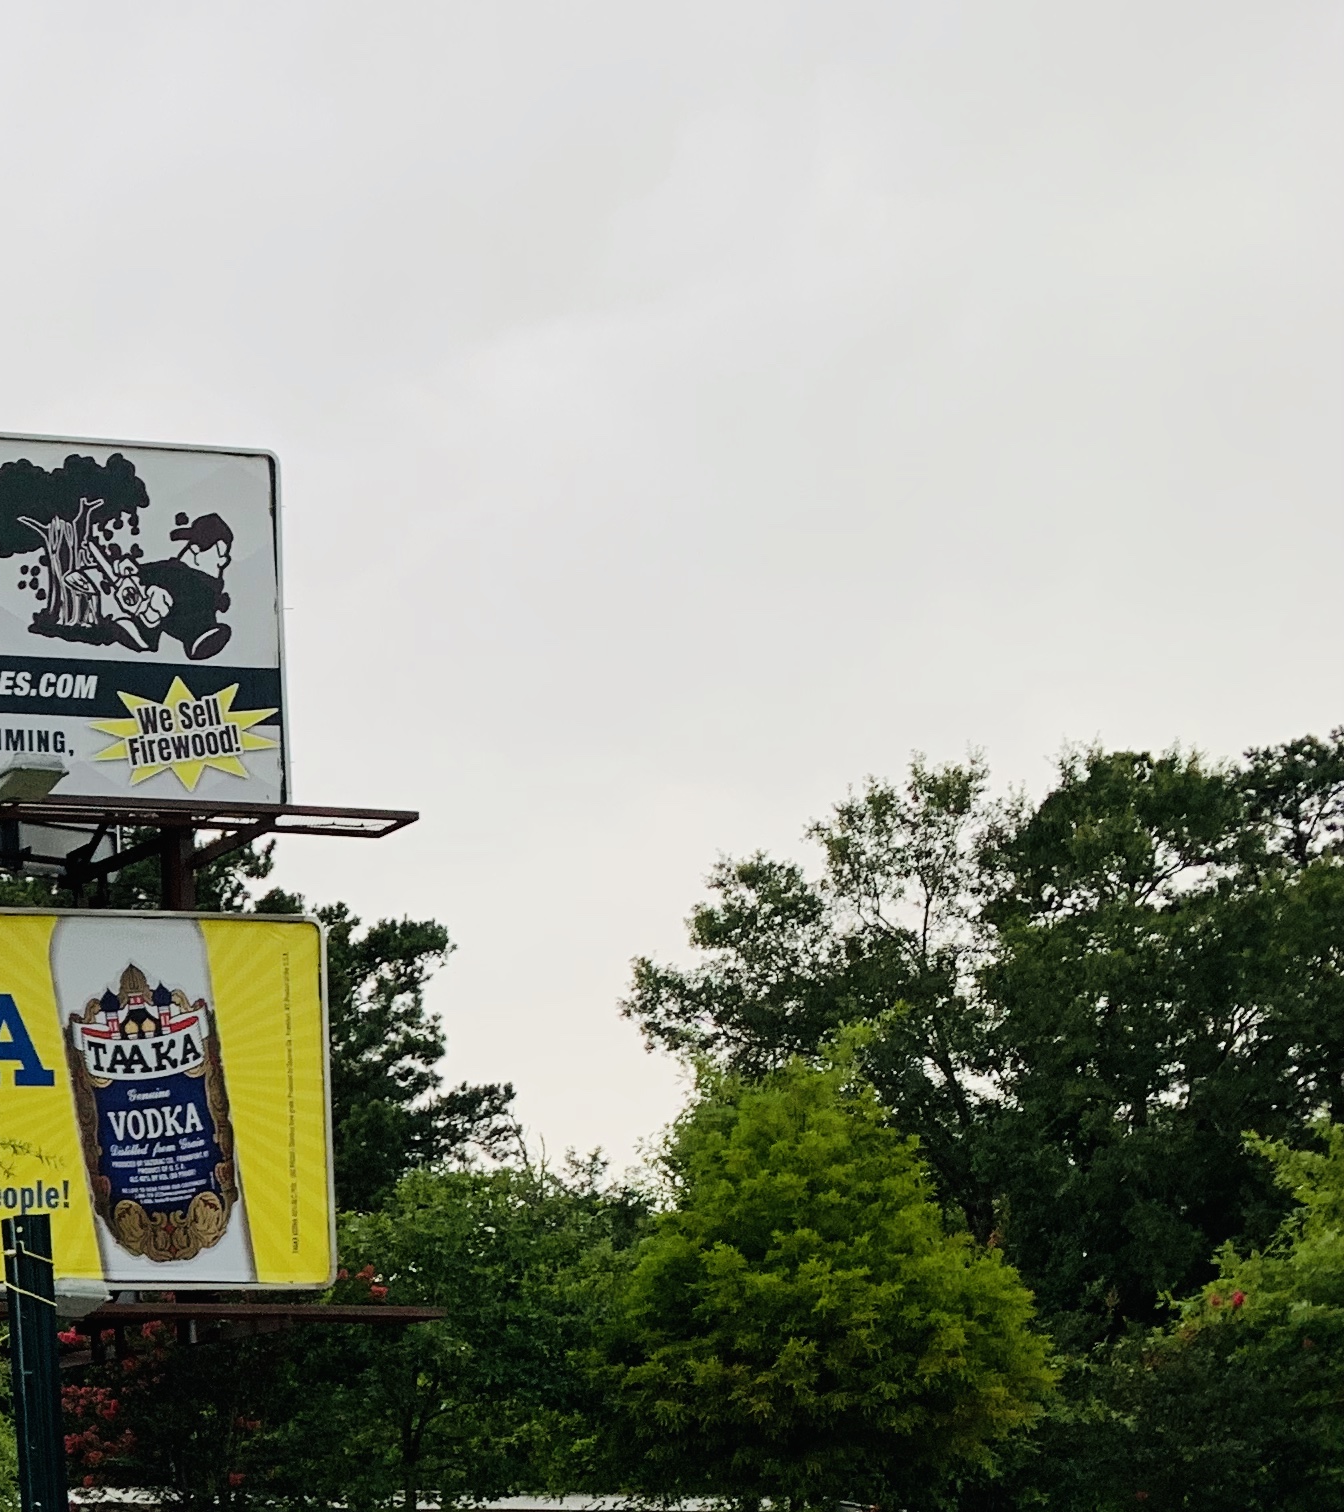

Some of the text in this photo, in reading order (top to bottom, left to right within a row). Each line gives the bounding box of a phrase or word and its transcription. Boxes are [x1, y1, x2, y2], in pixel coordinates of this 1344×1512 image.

[136, 697, 222, 735] We Sell
[128, 724, 242, 766] Firewood!
[87, 1033, 203, 1073] TAAKA
[107, 1102, 205, 1141] VODKA
